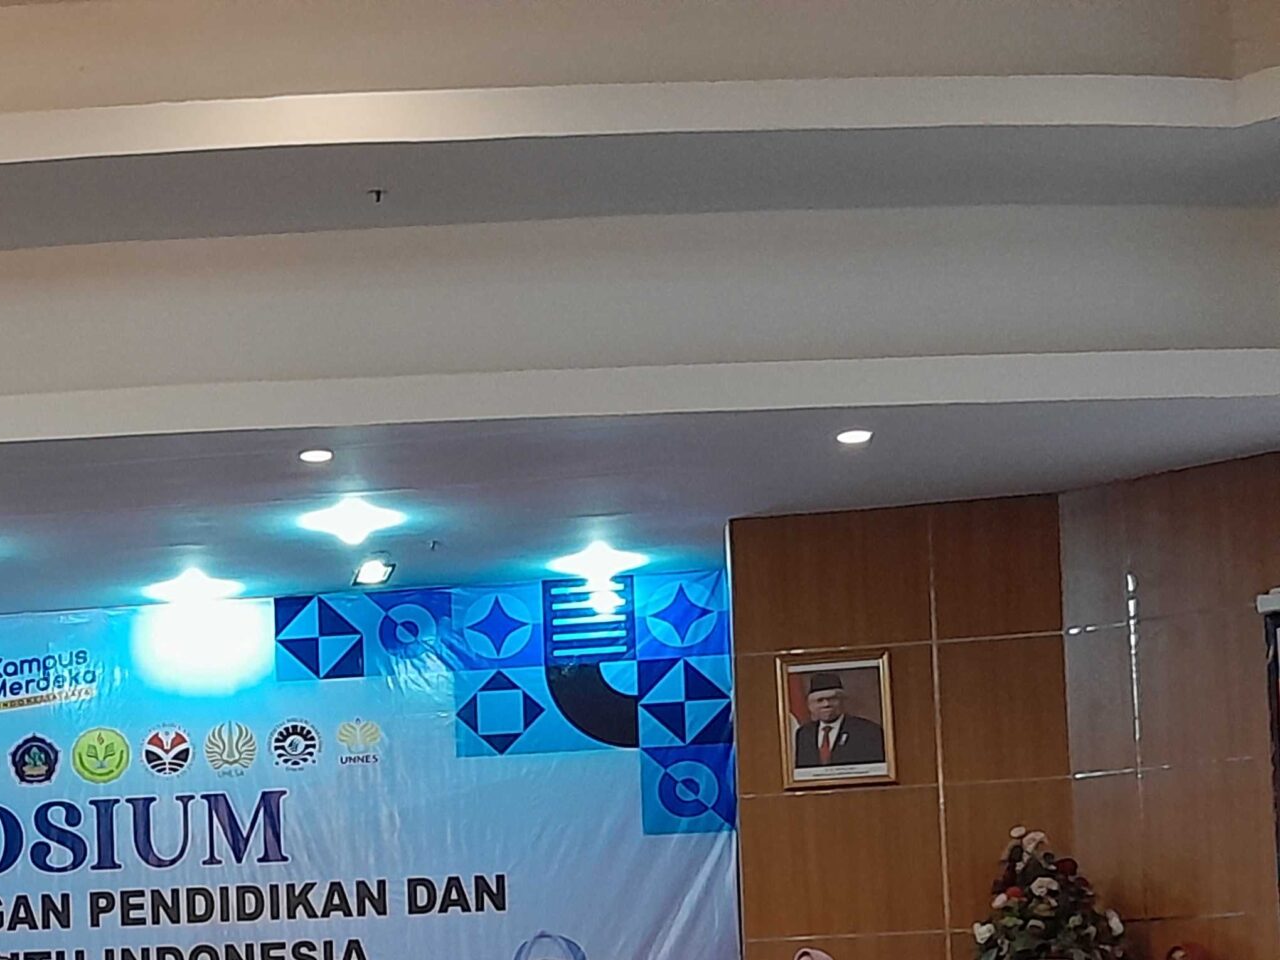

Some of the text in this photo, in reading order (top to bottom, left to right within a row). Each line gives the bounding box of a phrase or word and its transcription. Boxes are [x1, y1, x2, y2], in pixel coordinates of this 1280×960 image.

[340, 755, 379, 764] UNNES
[89, 880, 387, 927] PENDIDIKAN
[407, 874, 506, 914] DAN
